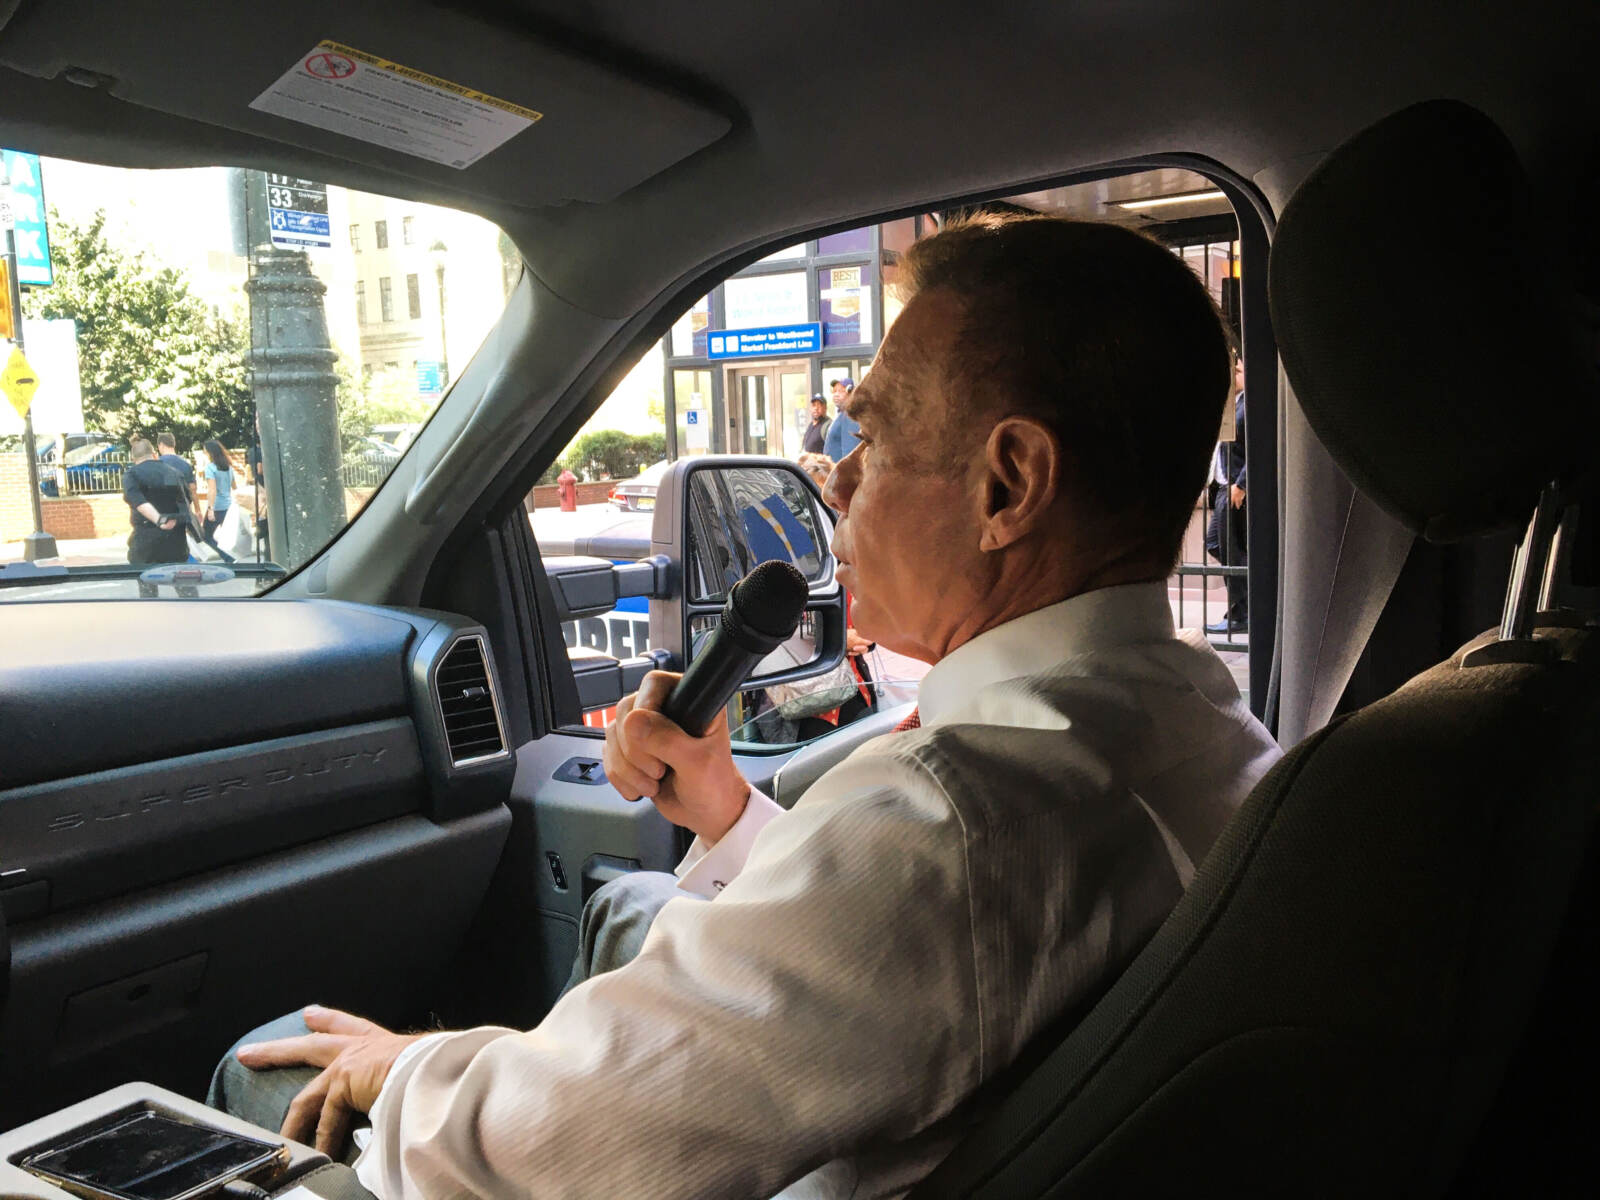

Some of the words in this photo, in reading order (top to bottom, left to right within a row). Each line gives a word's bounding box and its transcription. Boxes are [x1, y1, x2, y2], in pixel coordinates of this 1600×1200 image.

[270, 187, 293, 208] 33
[832, 270, 859, 281] BEST
[48, 777, 249, 832] SUPER
[262, 748, 388, 785] DUTY
